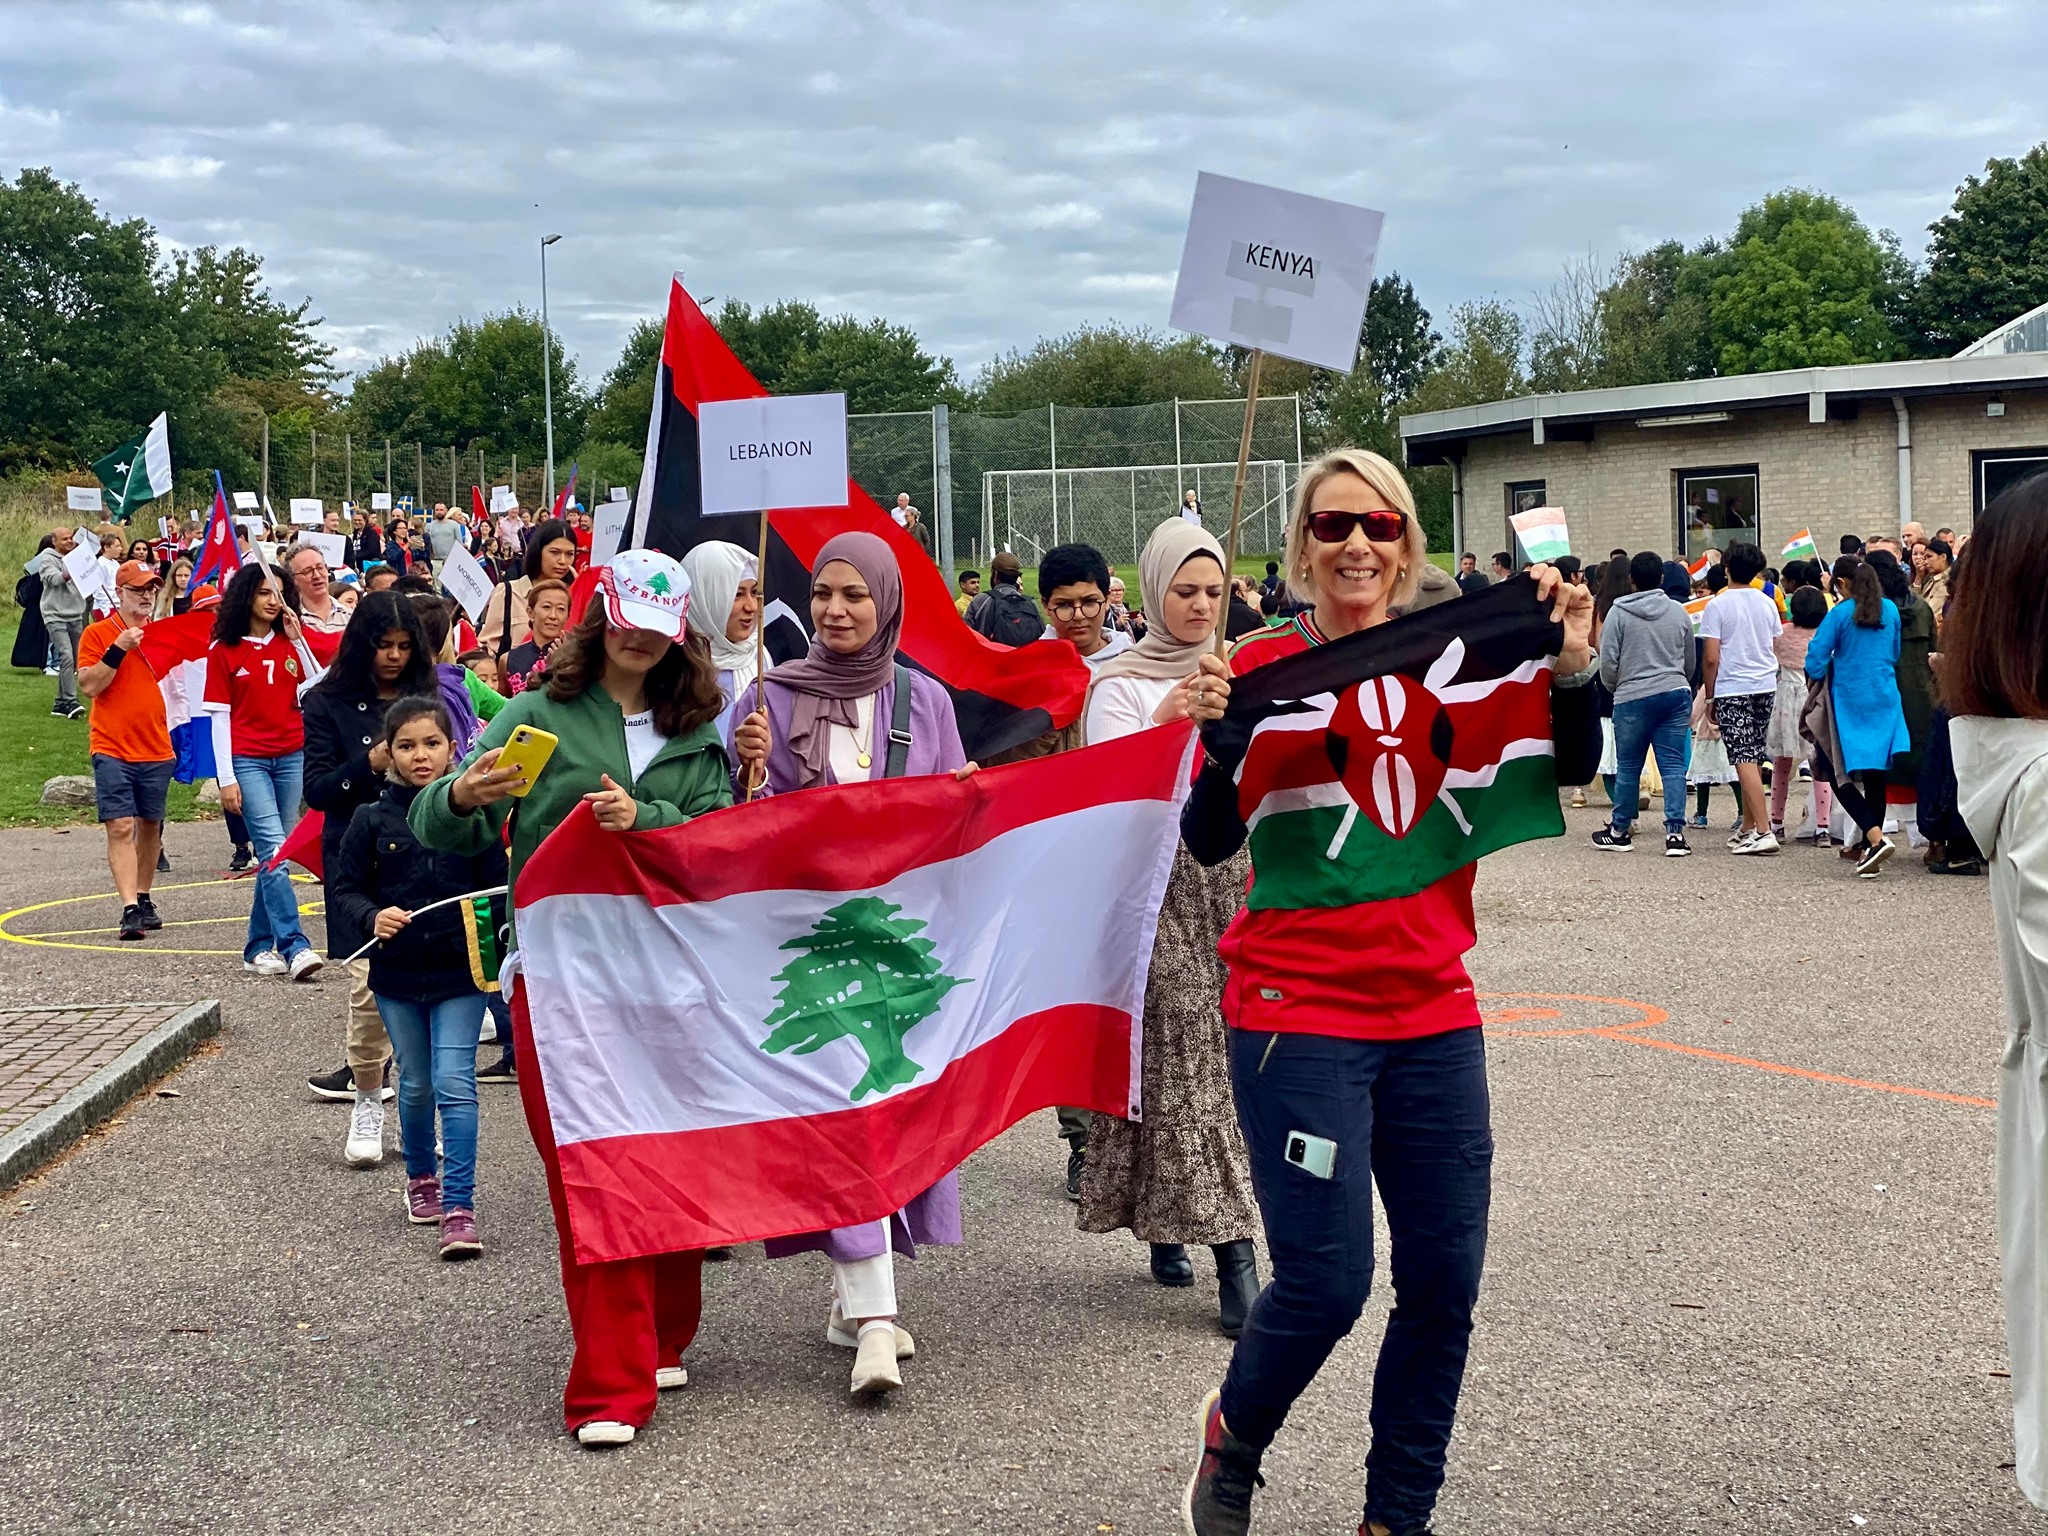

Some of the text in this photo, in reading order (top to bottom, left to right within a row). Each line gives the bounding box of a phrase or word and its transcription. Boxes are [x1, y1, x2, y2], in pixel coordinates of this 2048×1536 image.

[1246, 243, 1314, 279] KENYA
[730, 441, 812, 461] LEBANON
[457, 564, 483, 598] MOROCCO
[262, 659, 275, 685] 7
